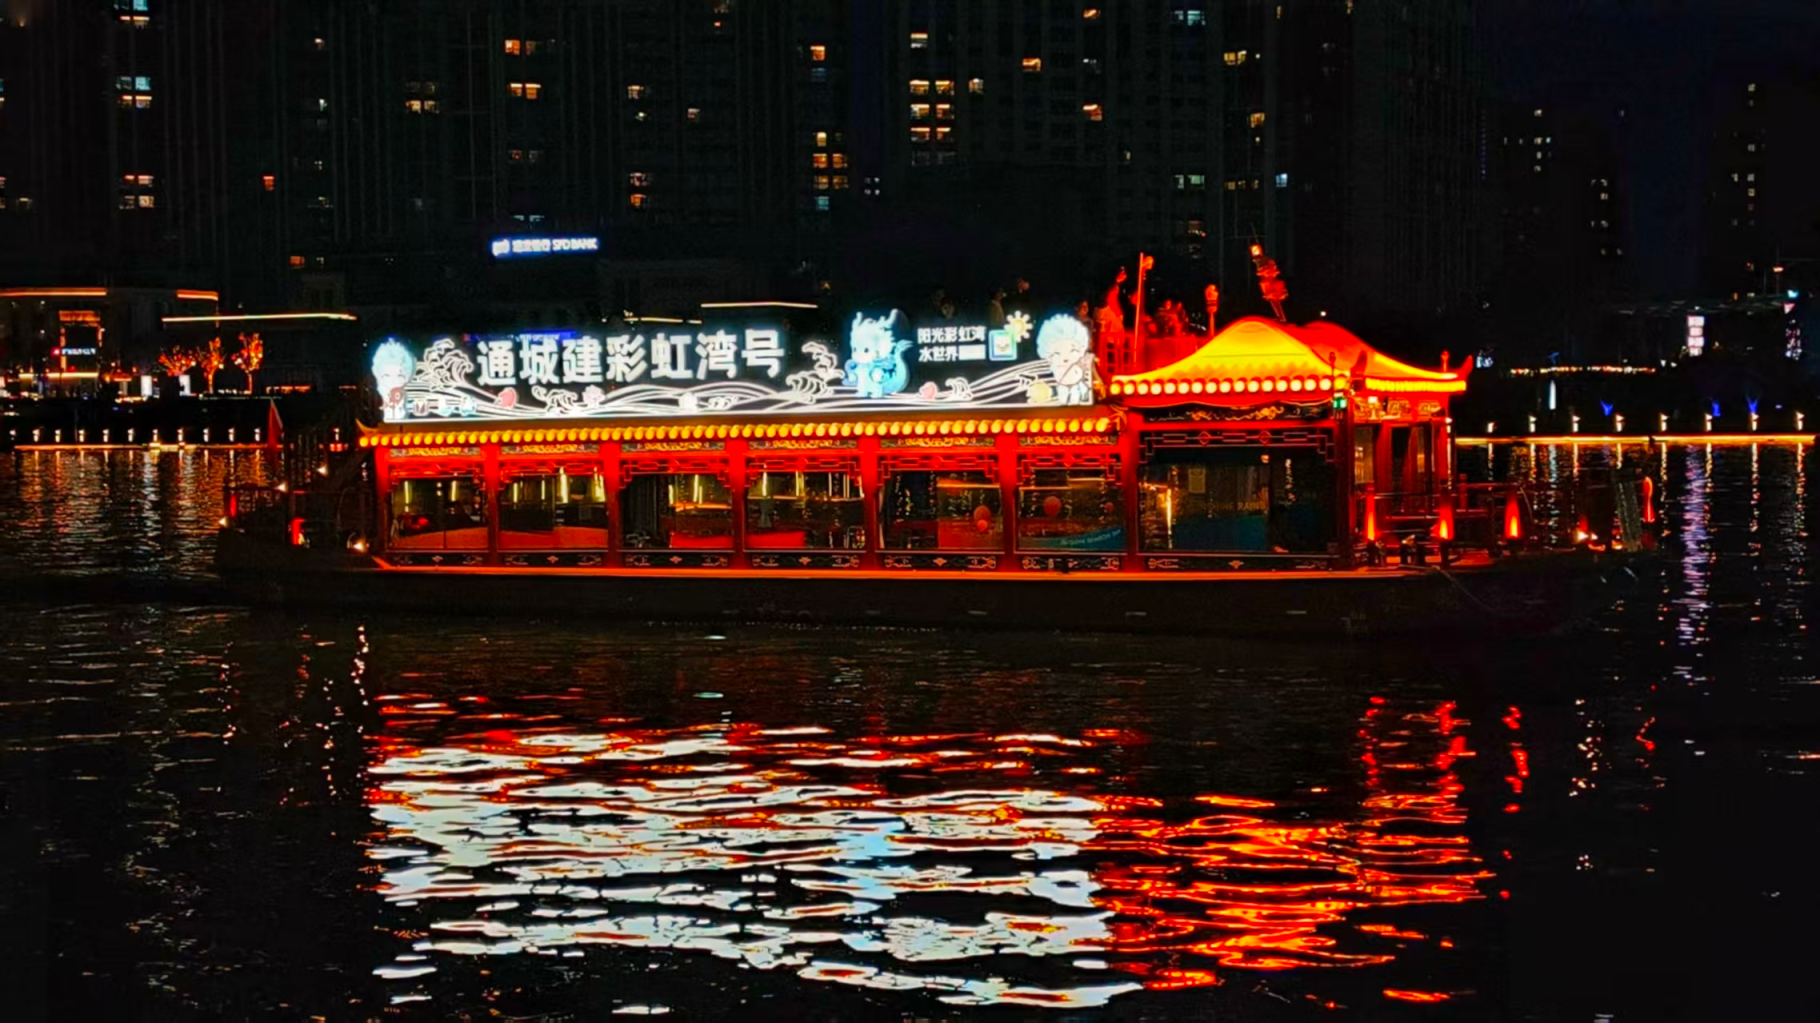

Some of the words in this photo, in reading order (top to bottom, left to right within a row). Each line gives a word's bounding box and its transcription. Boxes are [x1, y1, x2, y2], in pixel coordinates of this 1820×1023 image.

[917, 326, 986, 344] 阳光彩虹湾
[477, 329, 784, 386] 通城建彩虹湾号
[918, 345, 958, 362] 水世界
